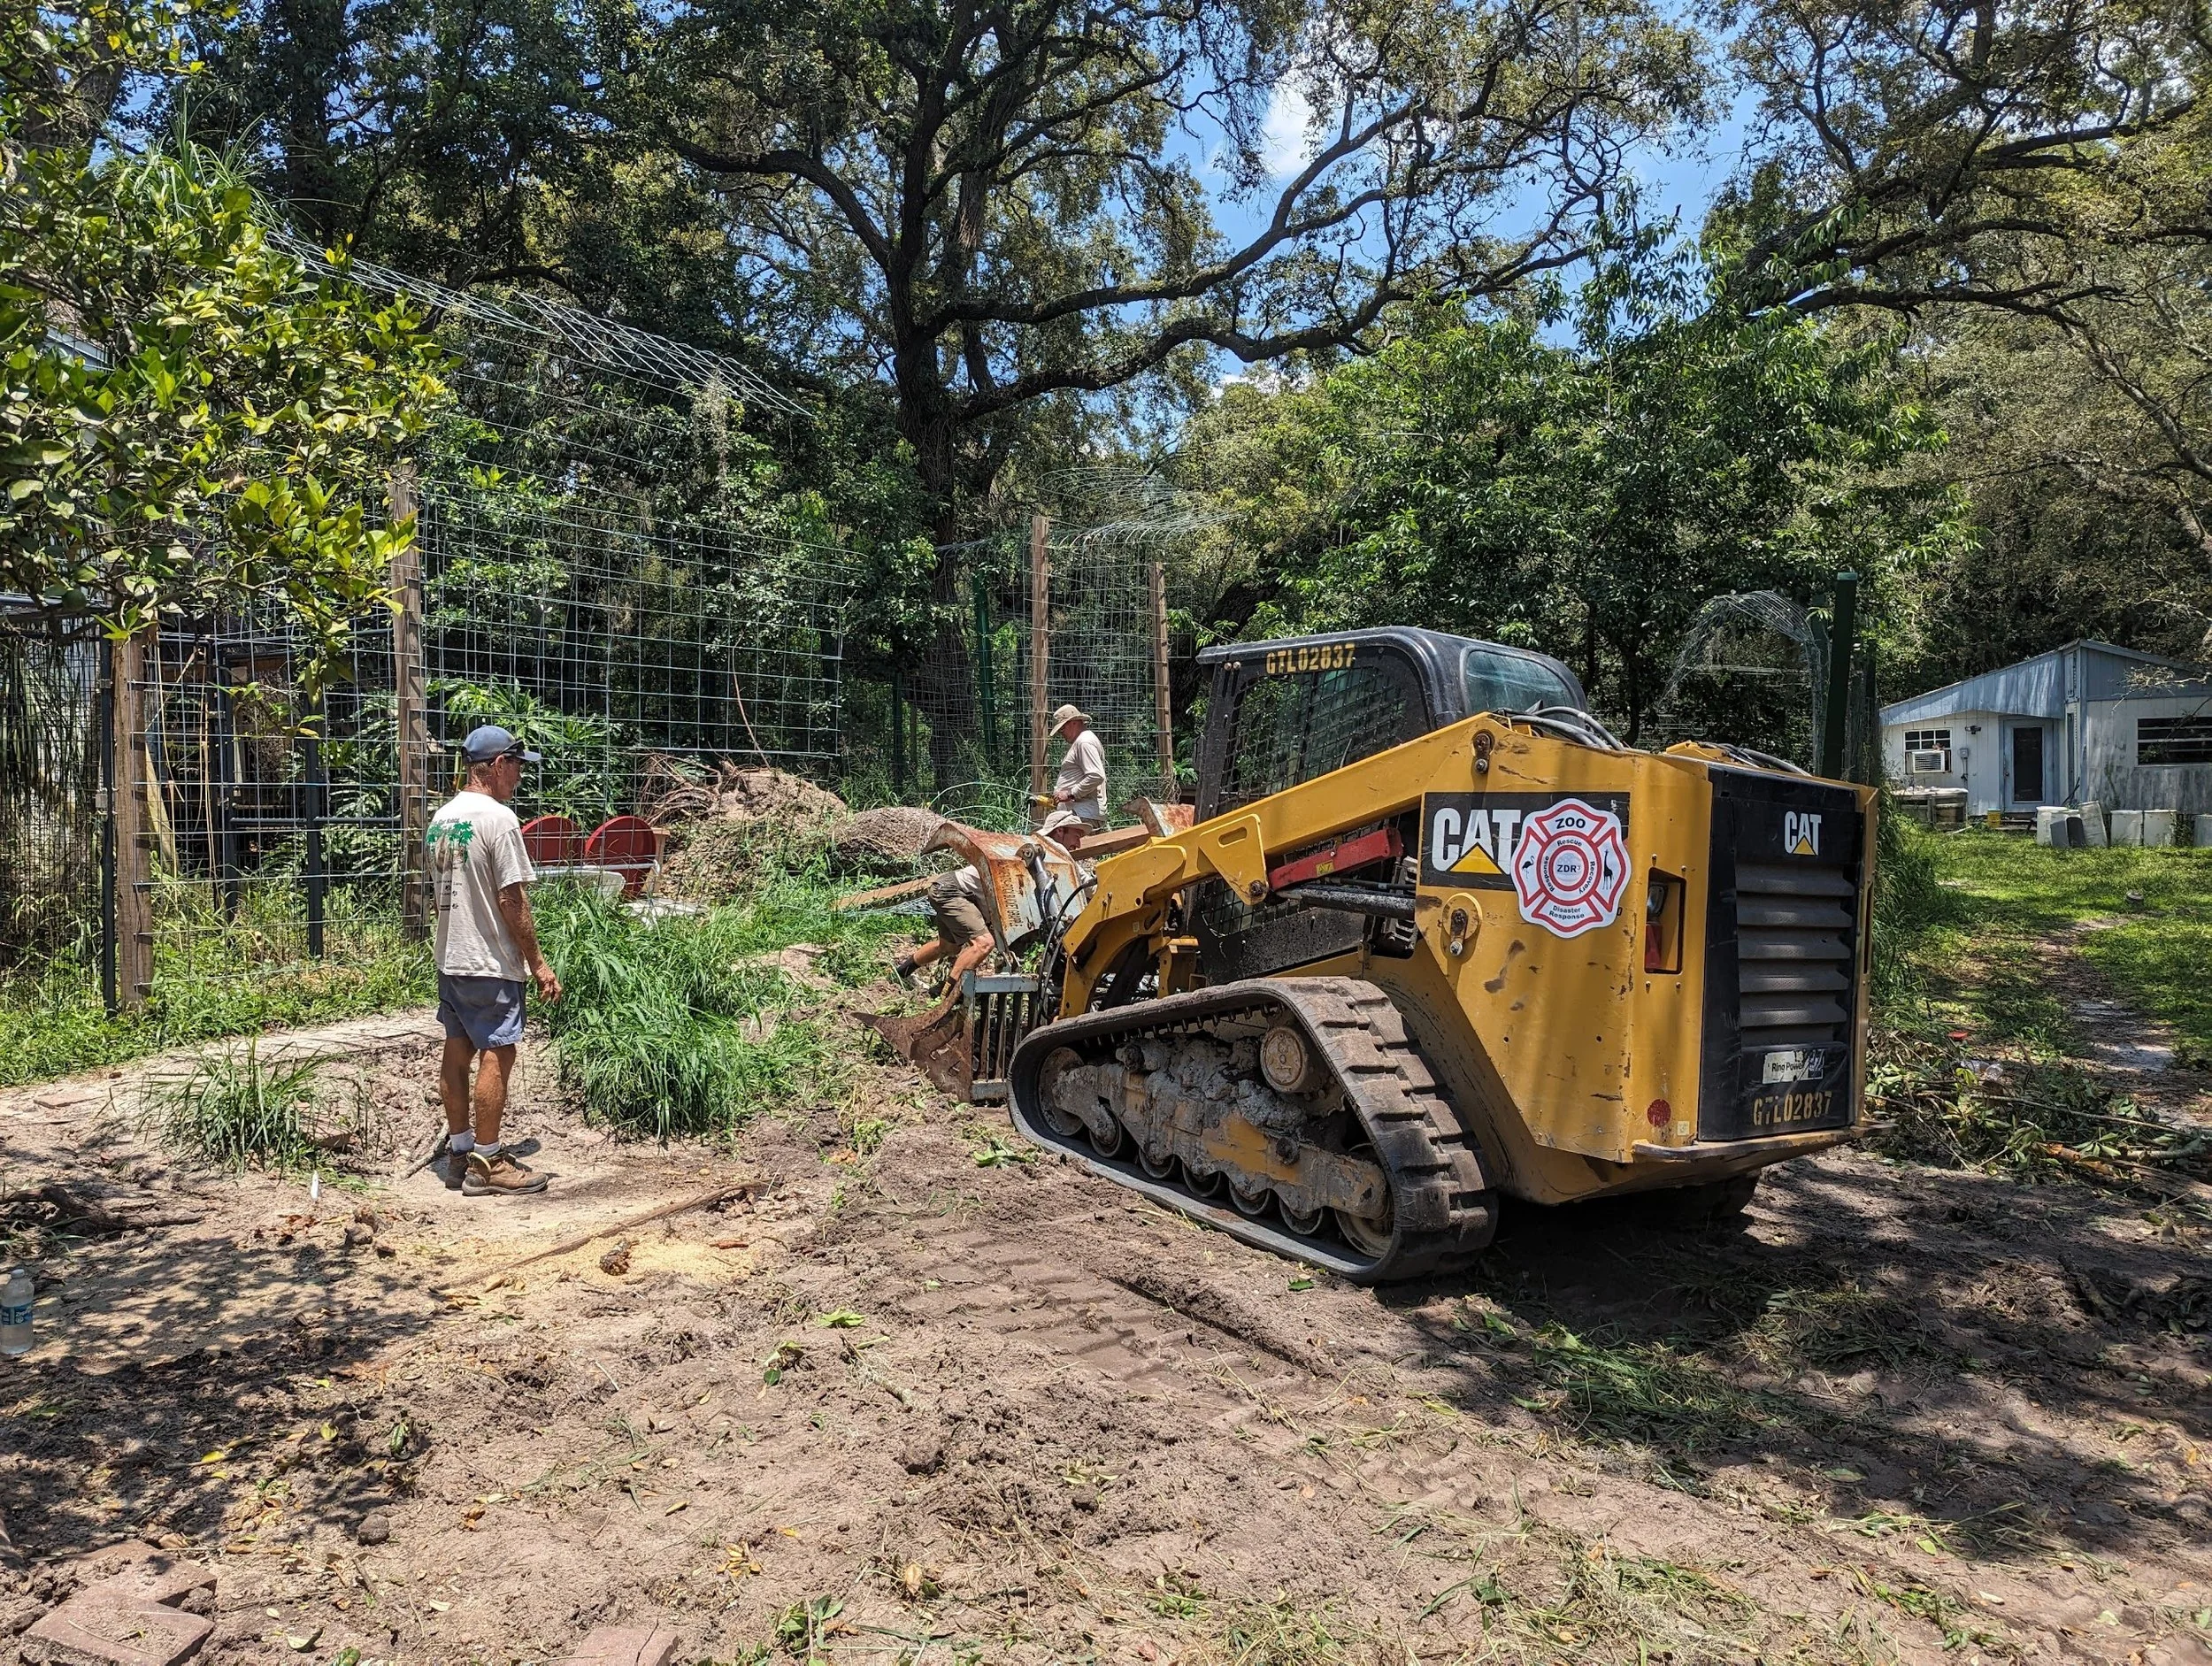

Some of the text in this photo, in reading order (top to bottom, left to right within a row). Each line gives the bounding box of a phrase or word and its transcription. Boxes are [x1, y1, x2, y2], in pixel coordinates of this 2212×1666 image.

[1266, 643, 1356, 674] GTL02837
[1555, 817, 1586, 830] ZOO
[1784, 810, 1822, 856] CAT
[1432, 807, 1521, 875] CAT
[1543, 856, 1555, 892] Response
[1578, 861, 1596, 894] Recovery
[1548, 910, 1585, 920] Response
[1552, 905, 1581, 914] Disaster
